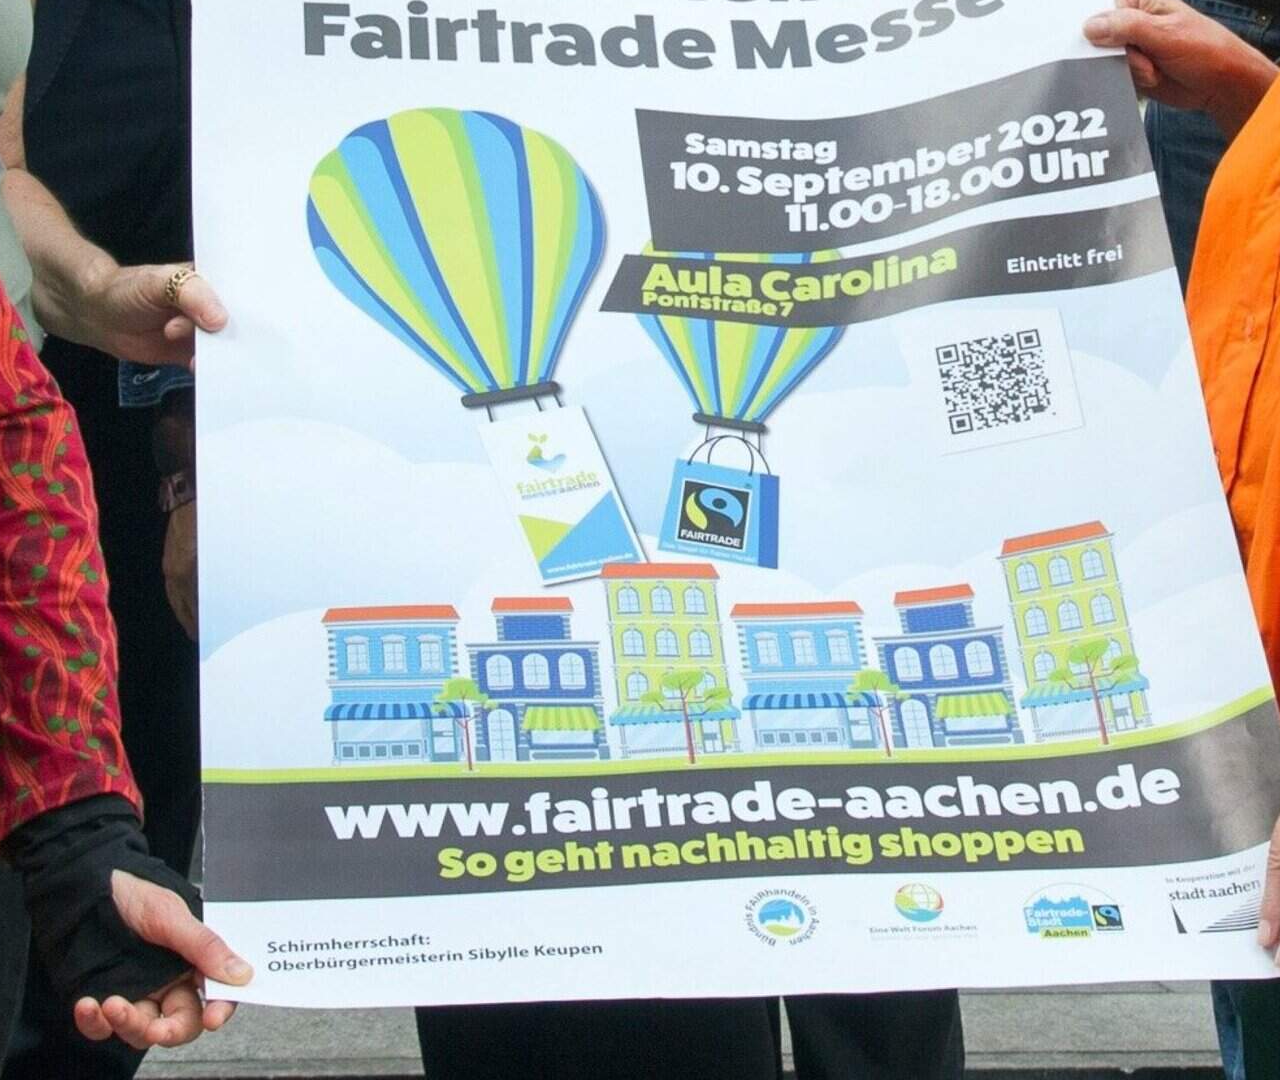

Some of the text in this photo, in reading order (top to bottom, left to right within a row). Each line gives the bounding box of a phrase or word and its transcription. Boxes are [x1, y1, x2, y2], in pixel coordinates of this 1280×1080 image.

[303, 0, 717, 71] Fairtrade
[670, 107, 1108, 204] 10. September 2022
[684, 132, 838, 165] Samstag
[1028, 147, 1110, 184] Uhr
[641, 247, 958, 302] Aula Carolina
[1006, 244, 1124, 275] Eintritt frei
[642, 290, 795, 318] Pontstraße 7
[516, 471, 598, 495] fairtrade
[680, 528, 742, 548] FAIRTRADE
[324, 763, 1182, 841] www.fairtrade-aachen.de
[437, 825, 1086, 883] So geht nachhaltig shoppen
[1169, 879, 1261, 901] stadt aachen
[267, 933, 431, 954] Schirmherrschaft:
[1043, 928, 1089, 938] Aachen
[267, 942, 604, 973] Oberbürgermeisterin Sibylle Keupen
